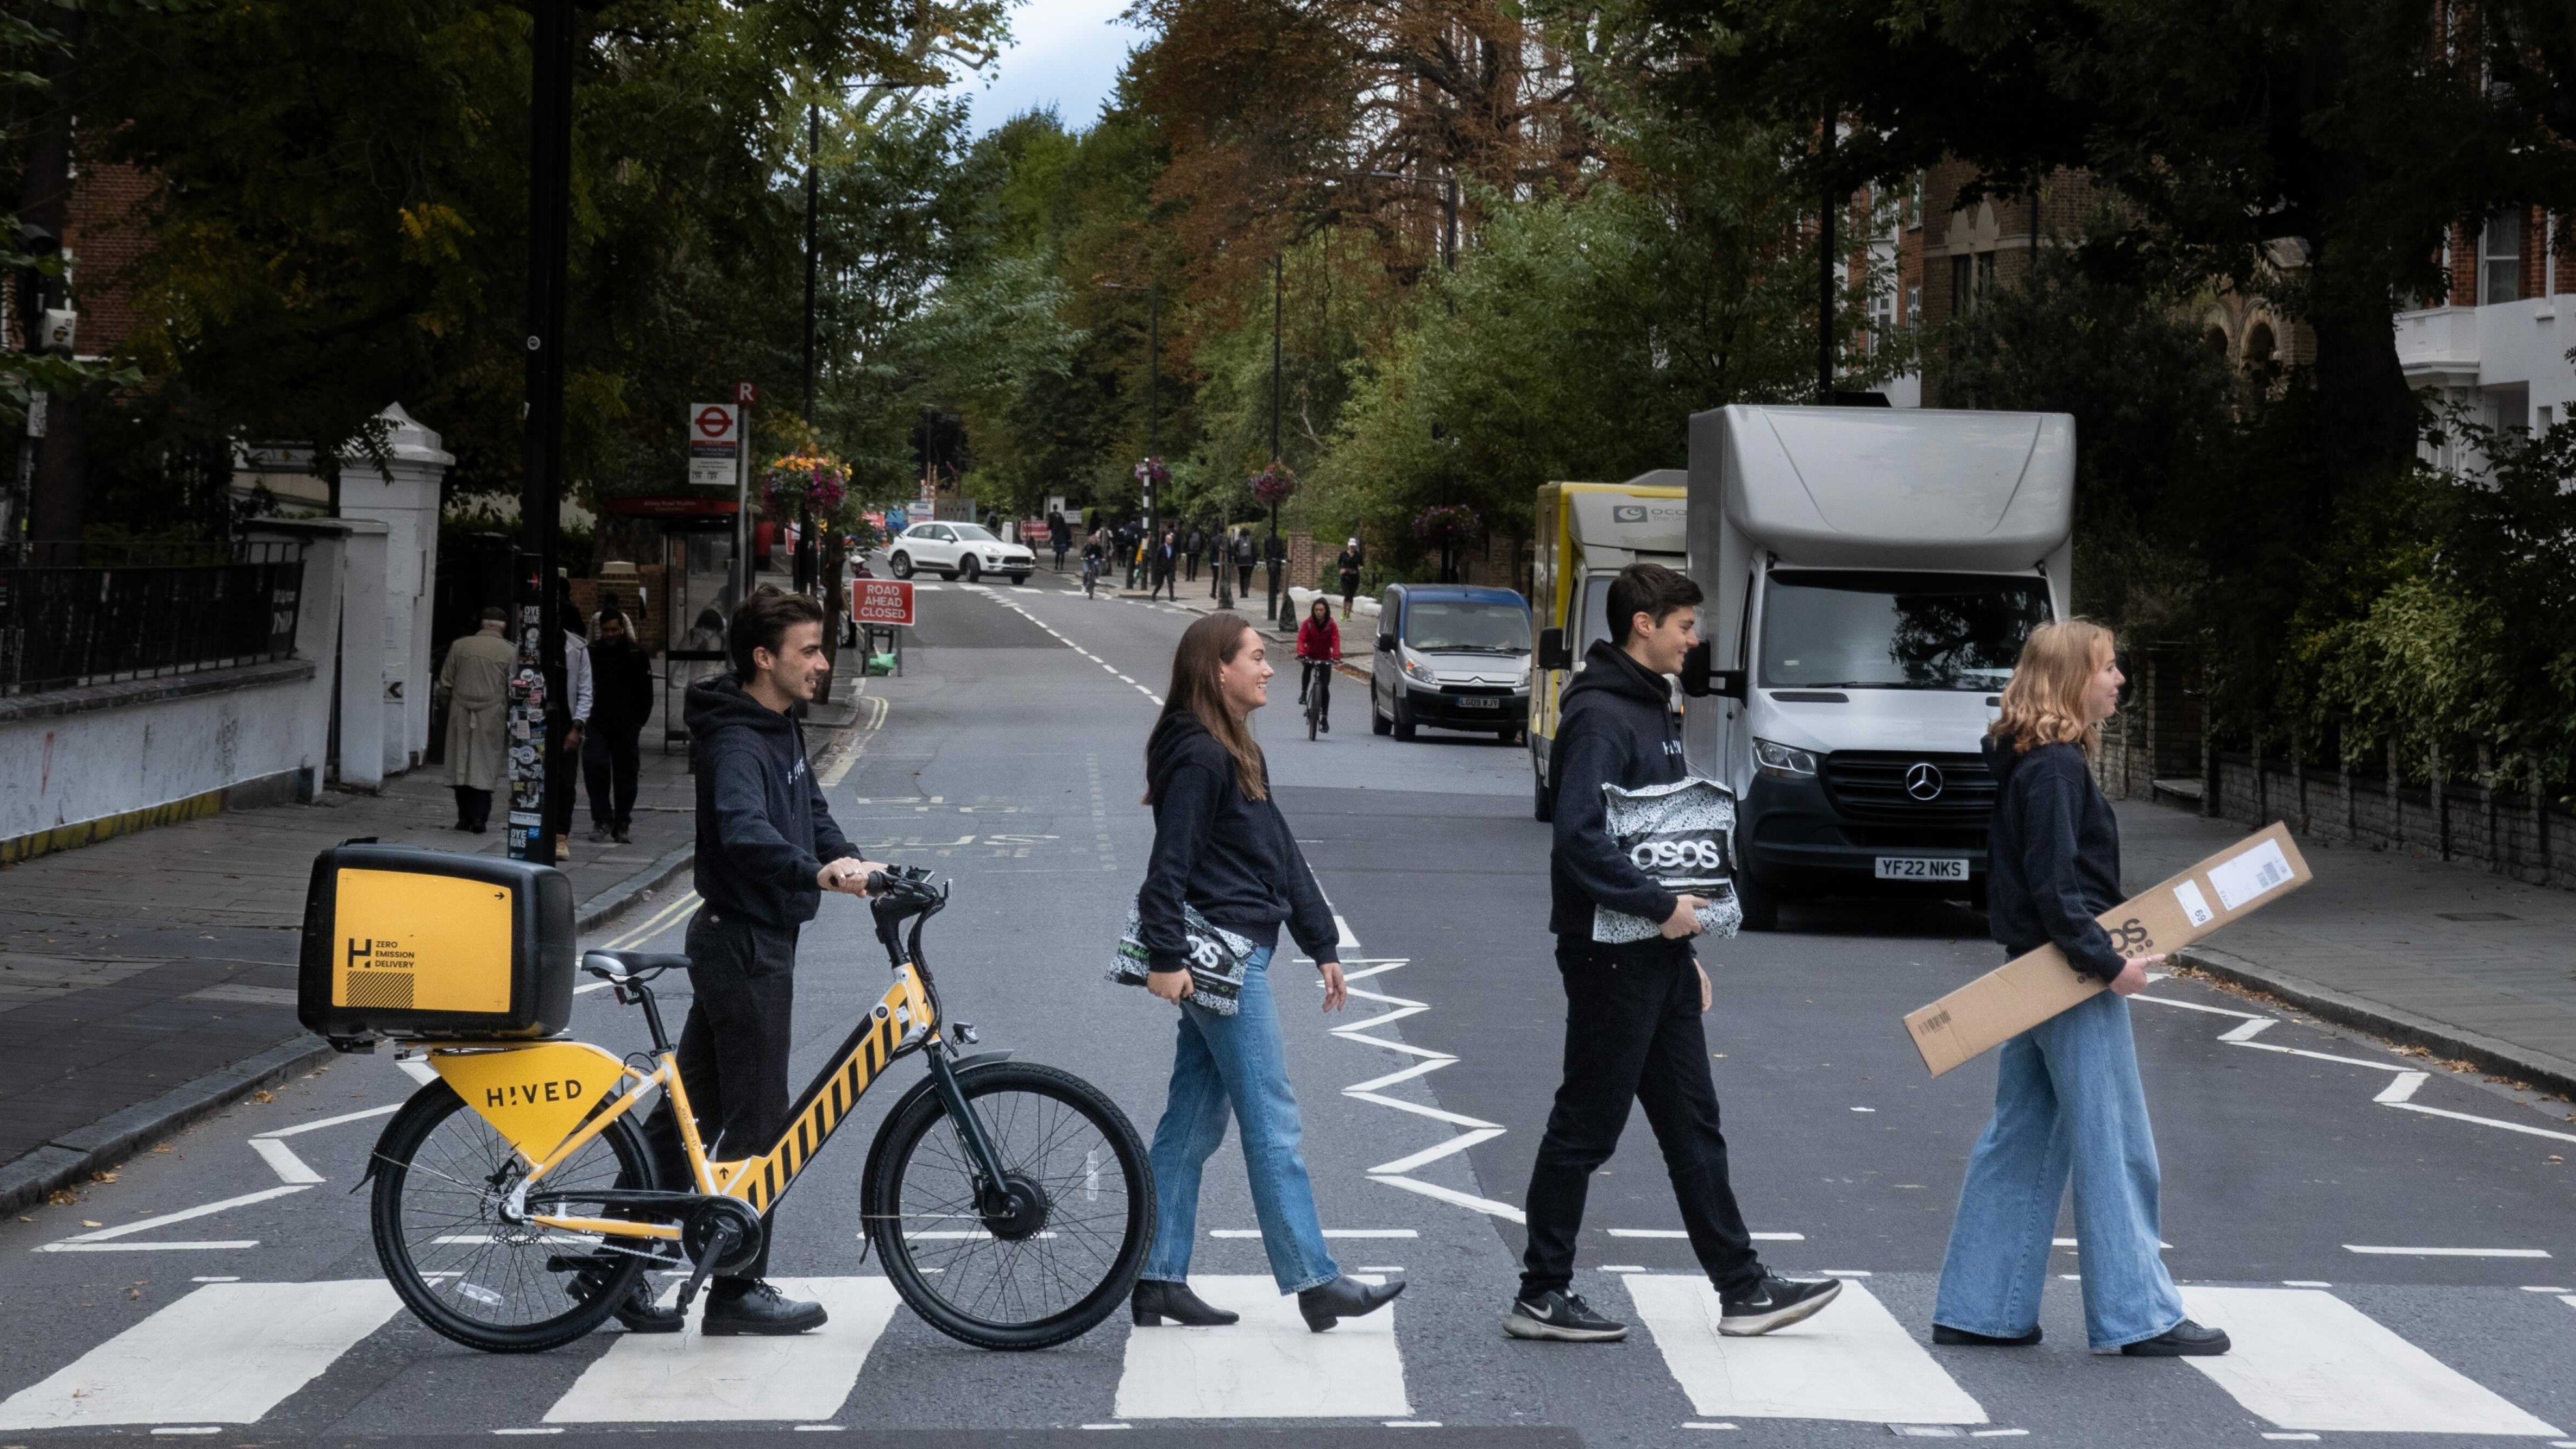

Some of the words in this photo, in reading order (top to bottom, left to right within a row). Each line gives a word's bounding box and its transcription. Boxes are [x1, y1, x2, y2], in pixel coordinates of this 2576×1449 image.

[739, 382, 754, 401] R
[867, 585, 900, 596] ROAD
[864, 596, 903, 607] AHEAD
[861, 607, 906, 619] CLOSED
[1883, 860, 1925, 875] YF22
[1930, 861, 1961, 876] NKS
